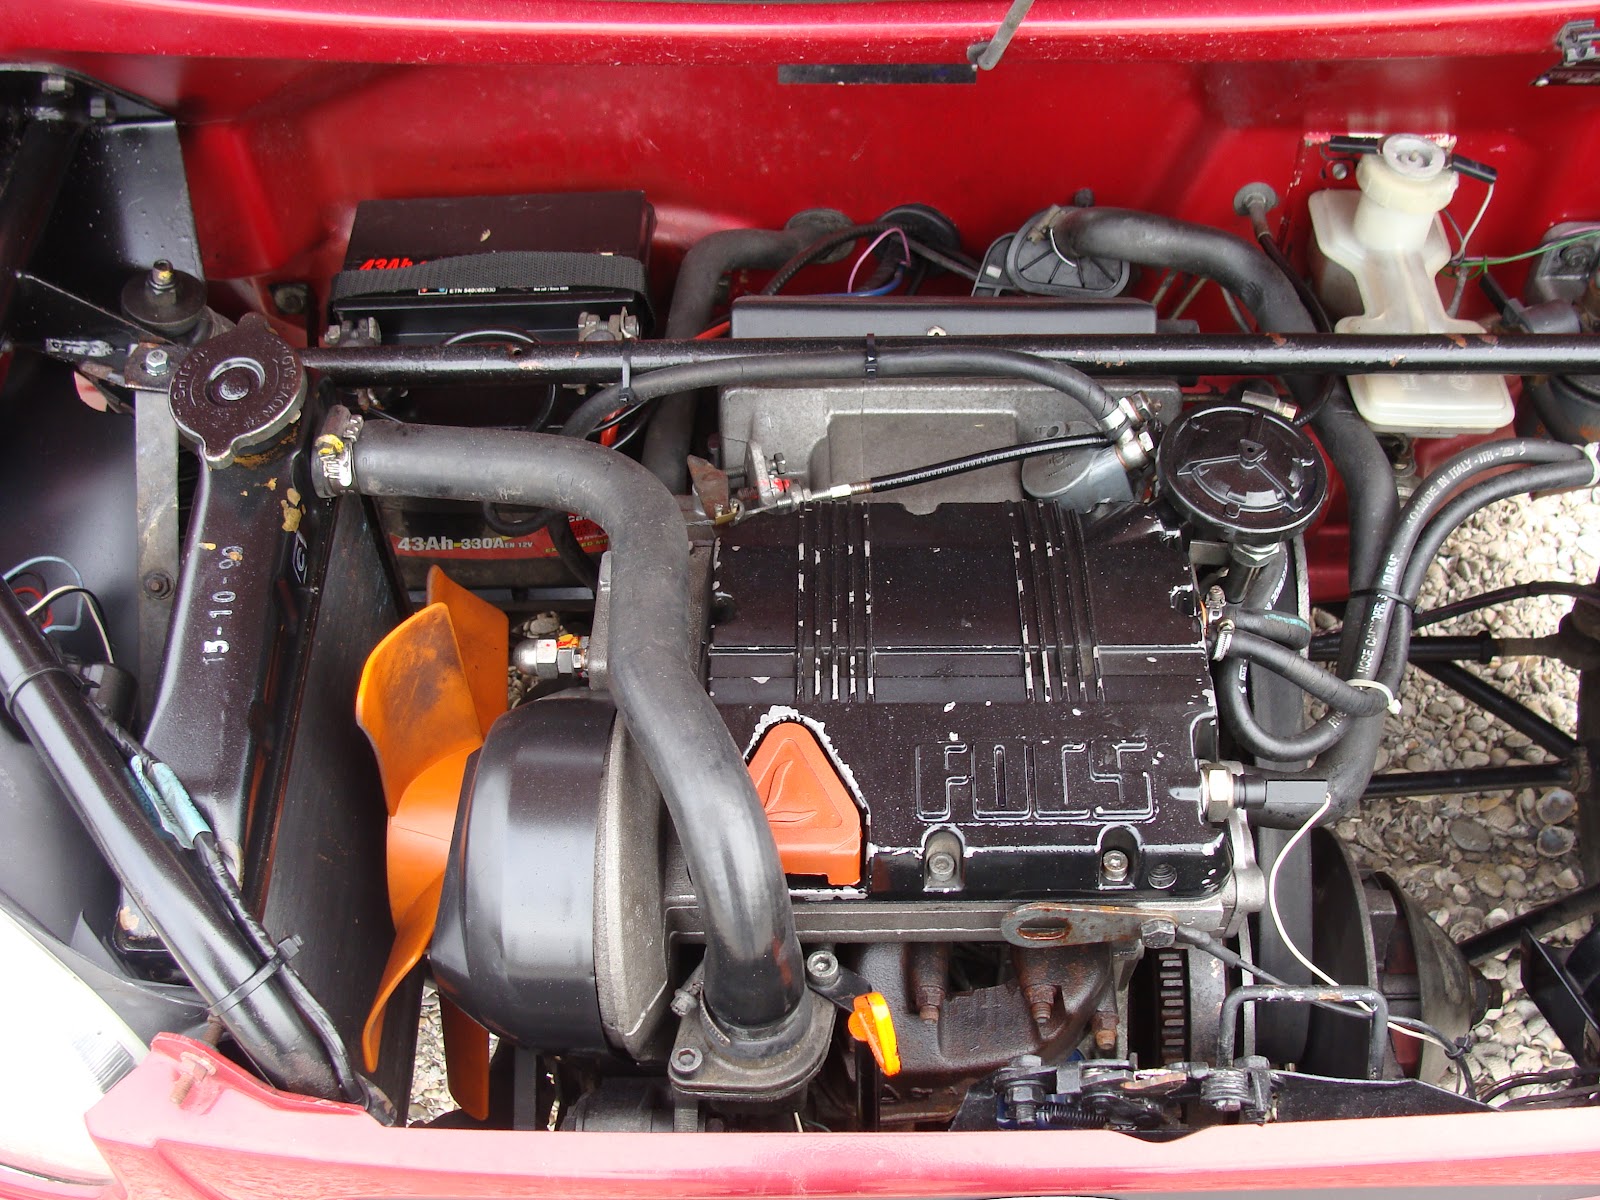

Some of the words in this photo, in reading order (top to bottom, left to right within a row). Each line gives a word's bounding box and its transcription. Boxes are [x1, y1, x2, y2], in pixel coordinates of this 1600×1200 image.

[1417, 484, 1438, 514] MADE
[1437, 474, 1448, 489] IN
[1449, 457, 1473, 480] ITALY
[398, 537, 454, 551] 43Ah
[461, 537, 504, 550] 330A
[1357, 643, 1374, 674] HOSE
[1381, 574, 1393, 586] 10
